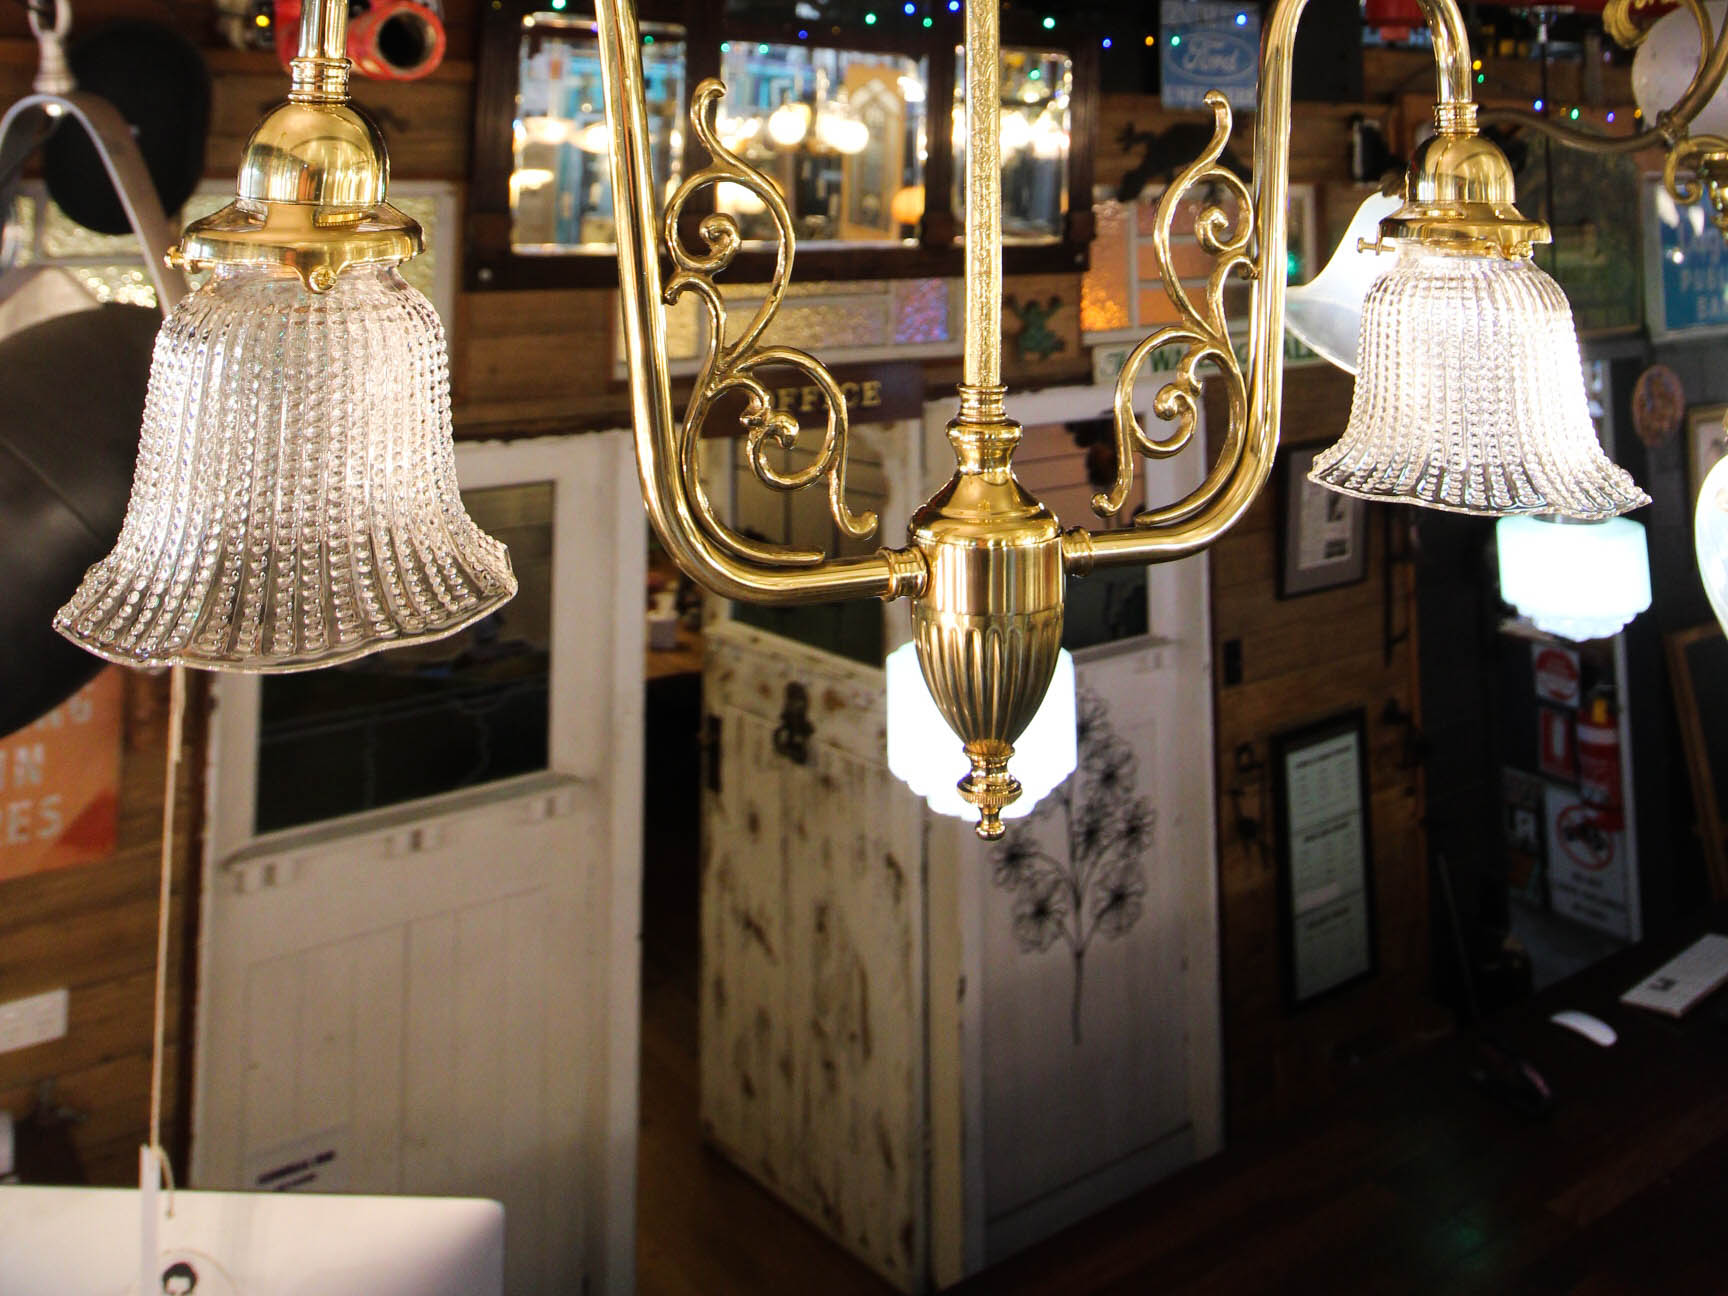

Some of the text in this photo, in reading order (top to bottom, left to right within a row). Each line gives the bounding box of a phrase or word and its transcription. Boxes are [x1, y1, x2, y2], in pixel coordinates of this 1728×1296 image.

[1181, 37, 1240, 71] Ford
[753, 380, 882, 413] FFCE
[0, 794, 63, 847] ES
